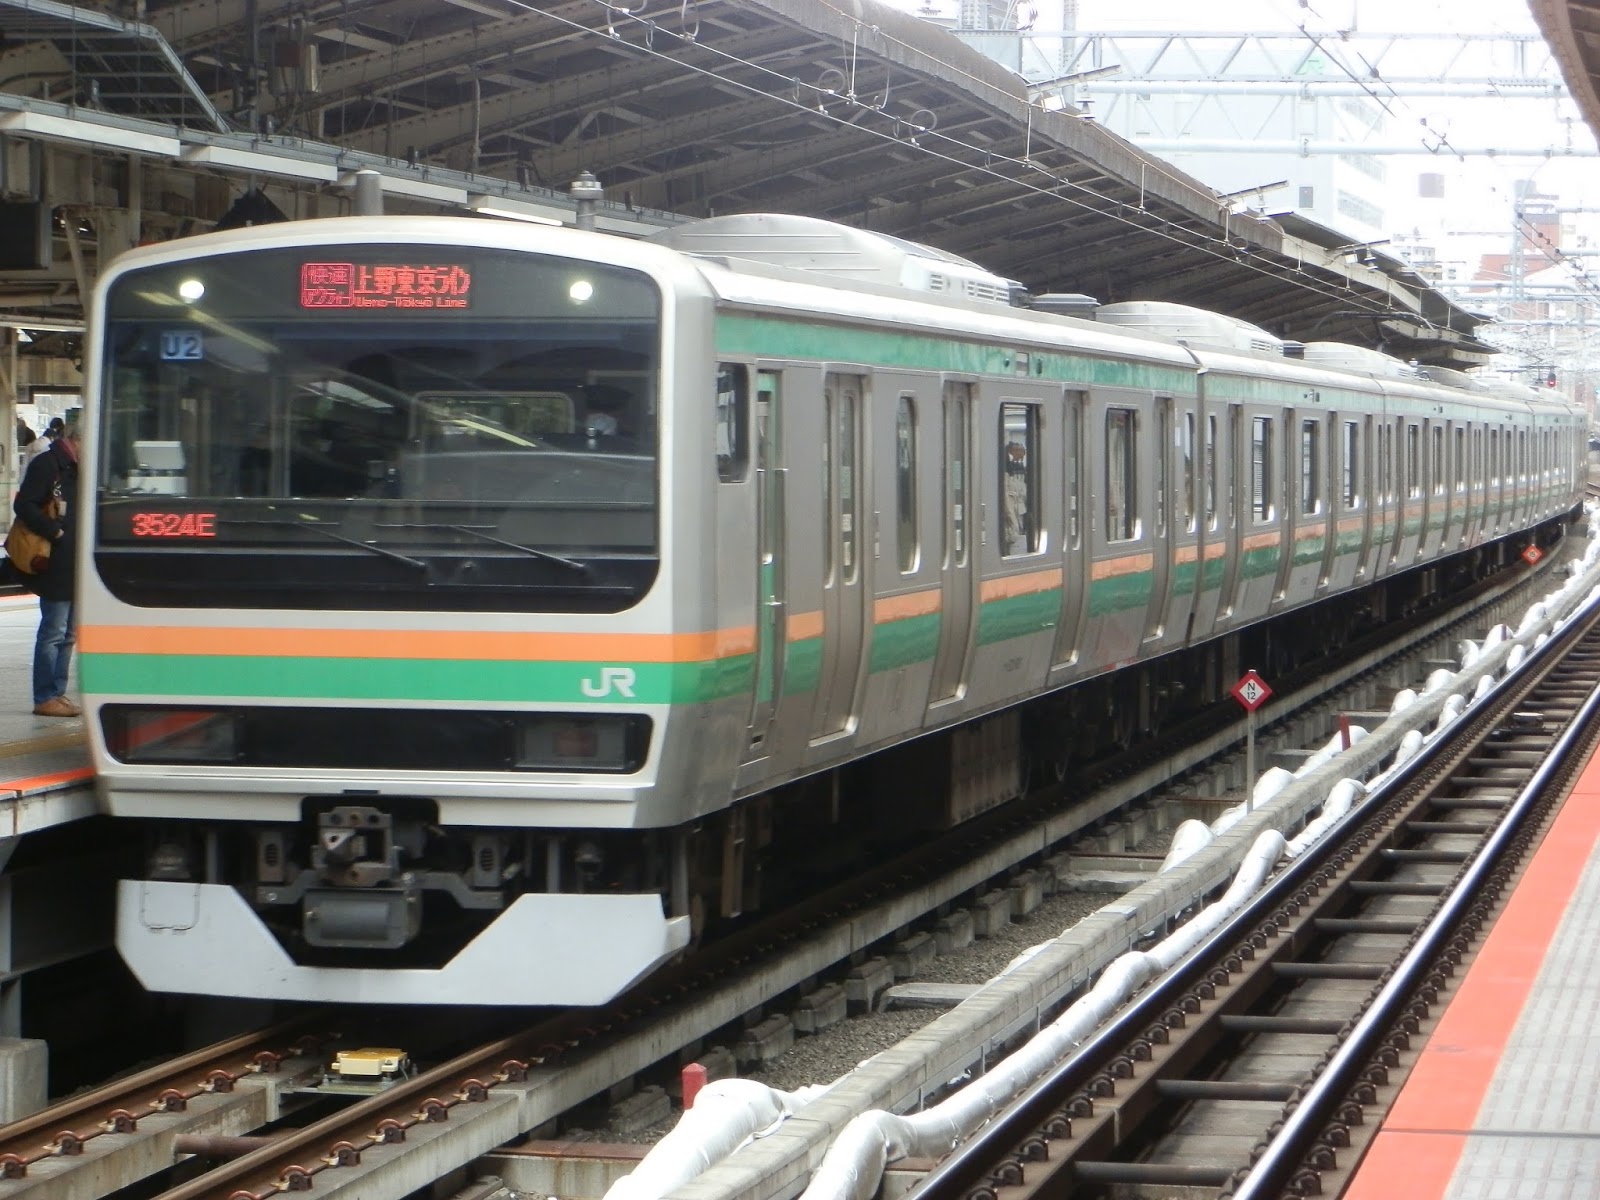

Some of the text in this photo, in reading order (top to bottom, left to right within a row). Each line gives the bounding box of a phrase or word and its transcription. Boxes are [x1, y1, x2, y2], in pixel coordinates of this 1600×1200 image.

[436, 297, 467, 308] Line
[165, 335, 200, 358] U2
[131, 513, 217, 537] 3524E
[581, 667, 636, 698] JR
[1247, 682, 1256, 691] N
[1247, 691, 1256, 700] 12
